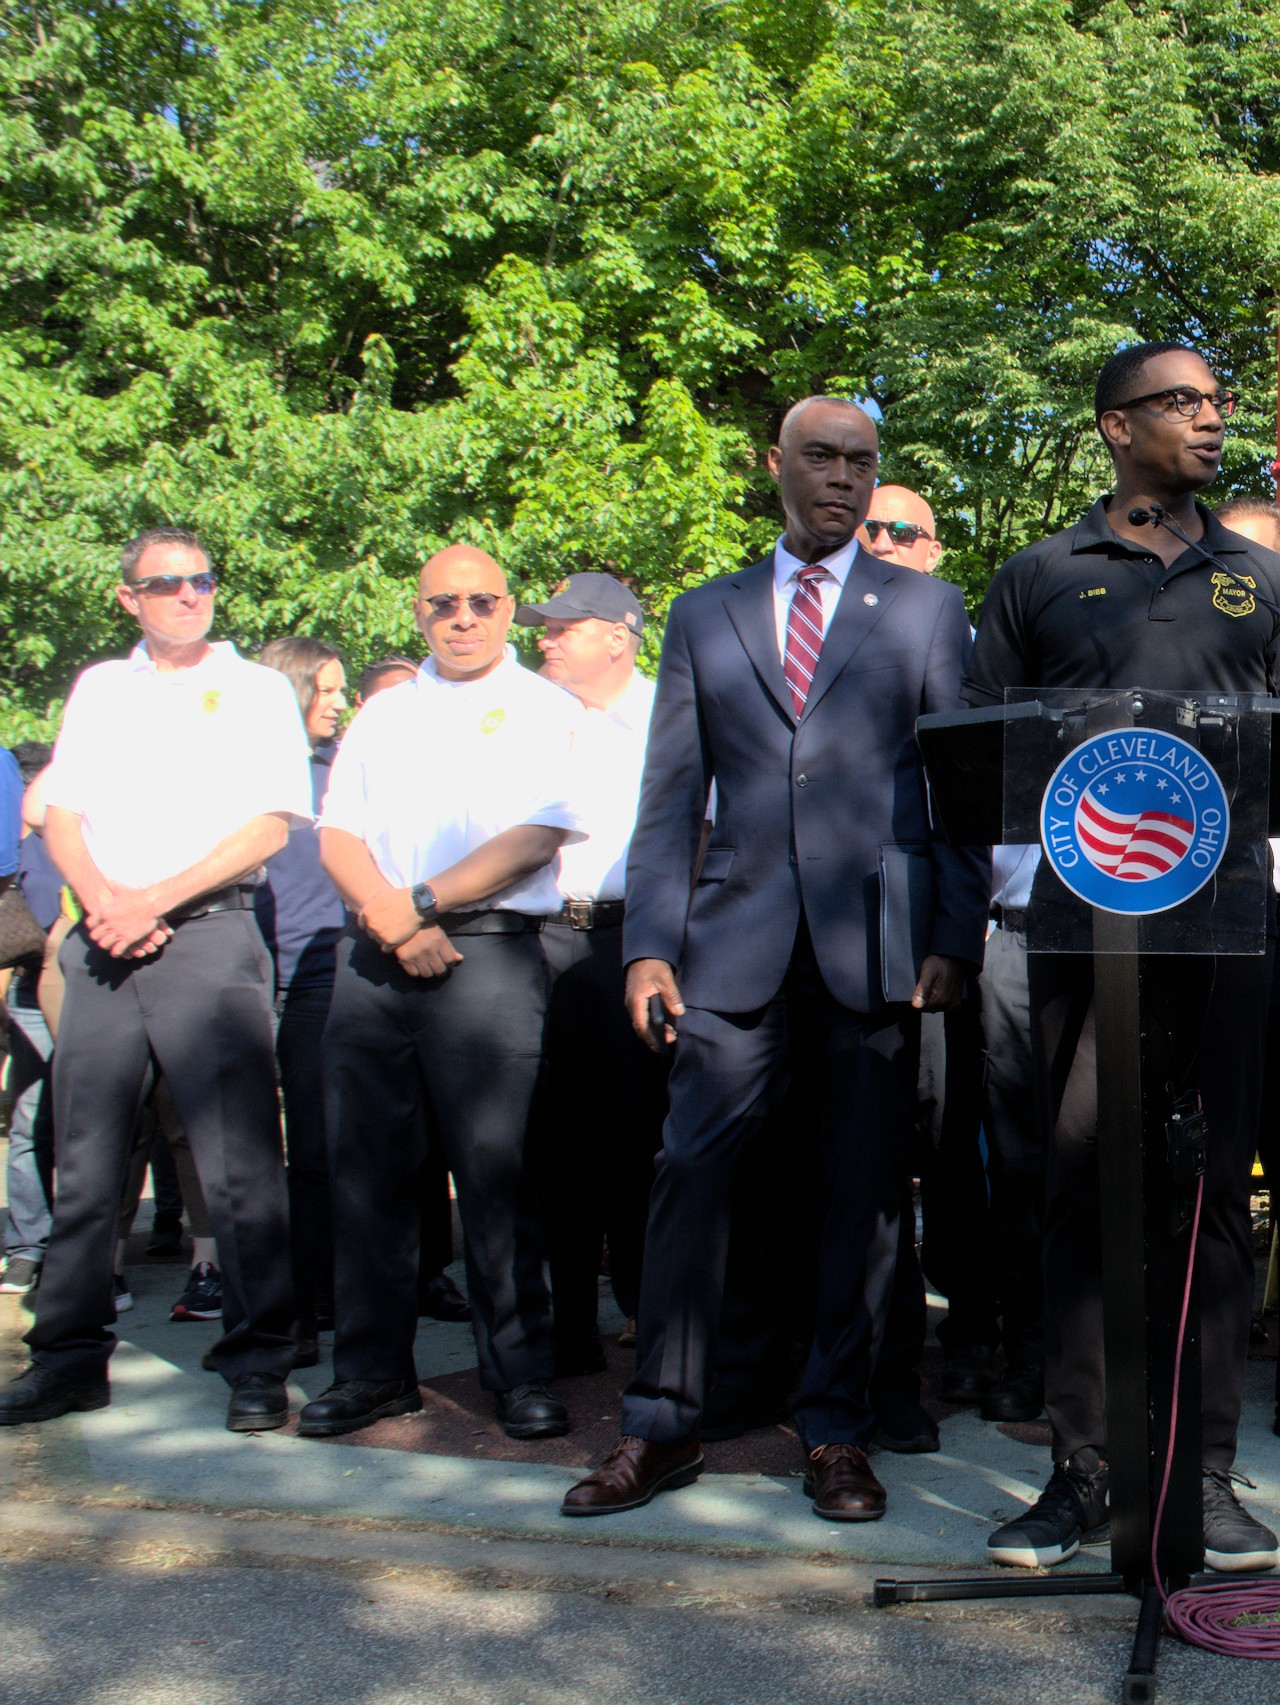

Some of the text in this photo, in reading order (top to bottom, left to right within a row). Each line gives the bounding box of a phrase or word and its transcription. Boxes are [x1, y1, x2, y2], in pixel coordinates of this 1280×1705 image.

[1079, 591, 1087, 599] J.
[1222, 588, 1246, 598] MAYOR
[1050, 737, 1222, 868] CITY OF CLEVELAND OHIO
